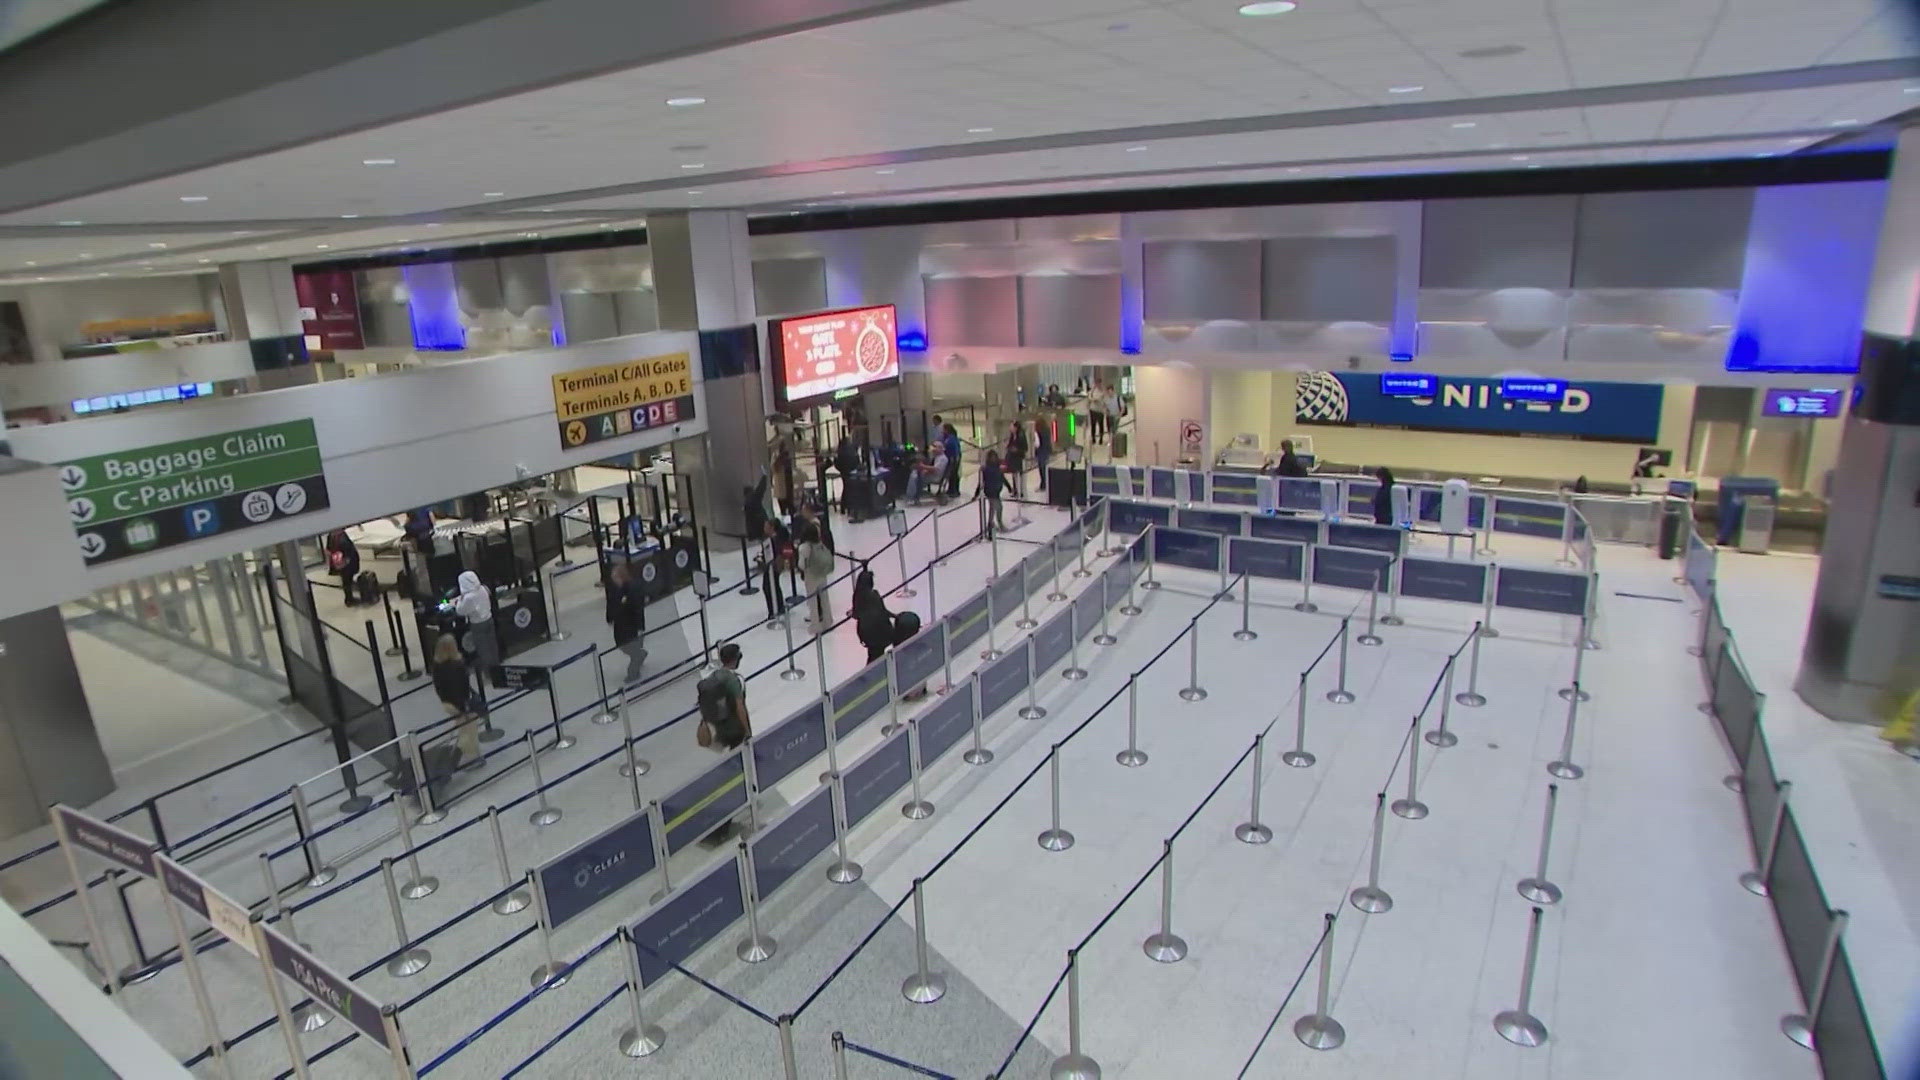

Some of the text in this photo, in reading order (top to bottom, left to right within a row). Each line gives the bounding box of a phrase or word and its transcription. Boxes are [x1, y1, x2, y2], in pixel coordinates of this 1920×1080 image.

[560, 360, 686, 393] Terminal C/All Gates
[563, 379, 687, 416] Terminals A, B, D, E
[601, 415, 615, 436] A
[633, 408, 646, 424] C
[649, 405, 660, 420] D
[663, 401, 675, 417] E
[103, 432, 286, 481] Baggage Claim
[113, 474, 235, 511] C-Parking
[192, 508, 212, 532] P
[594, 851, 625, 874] CLEAR
